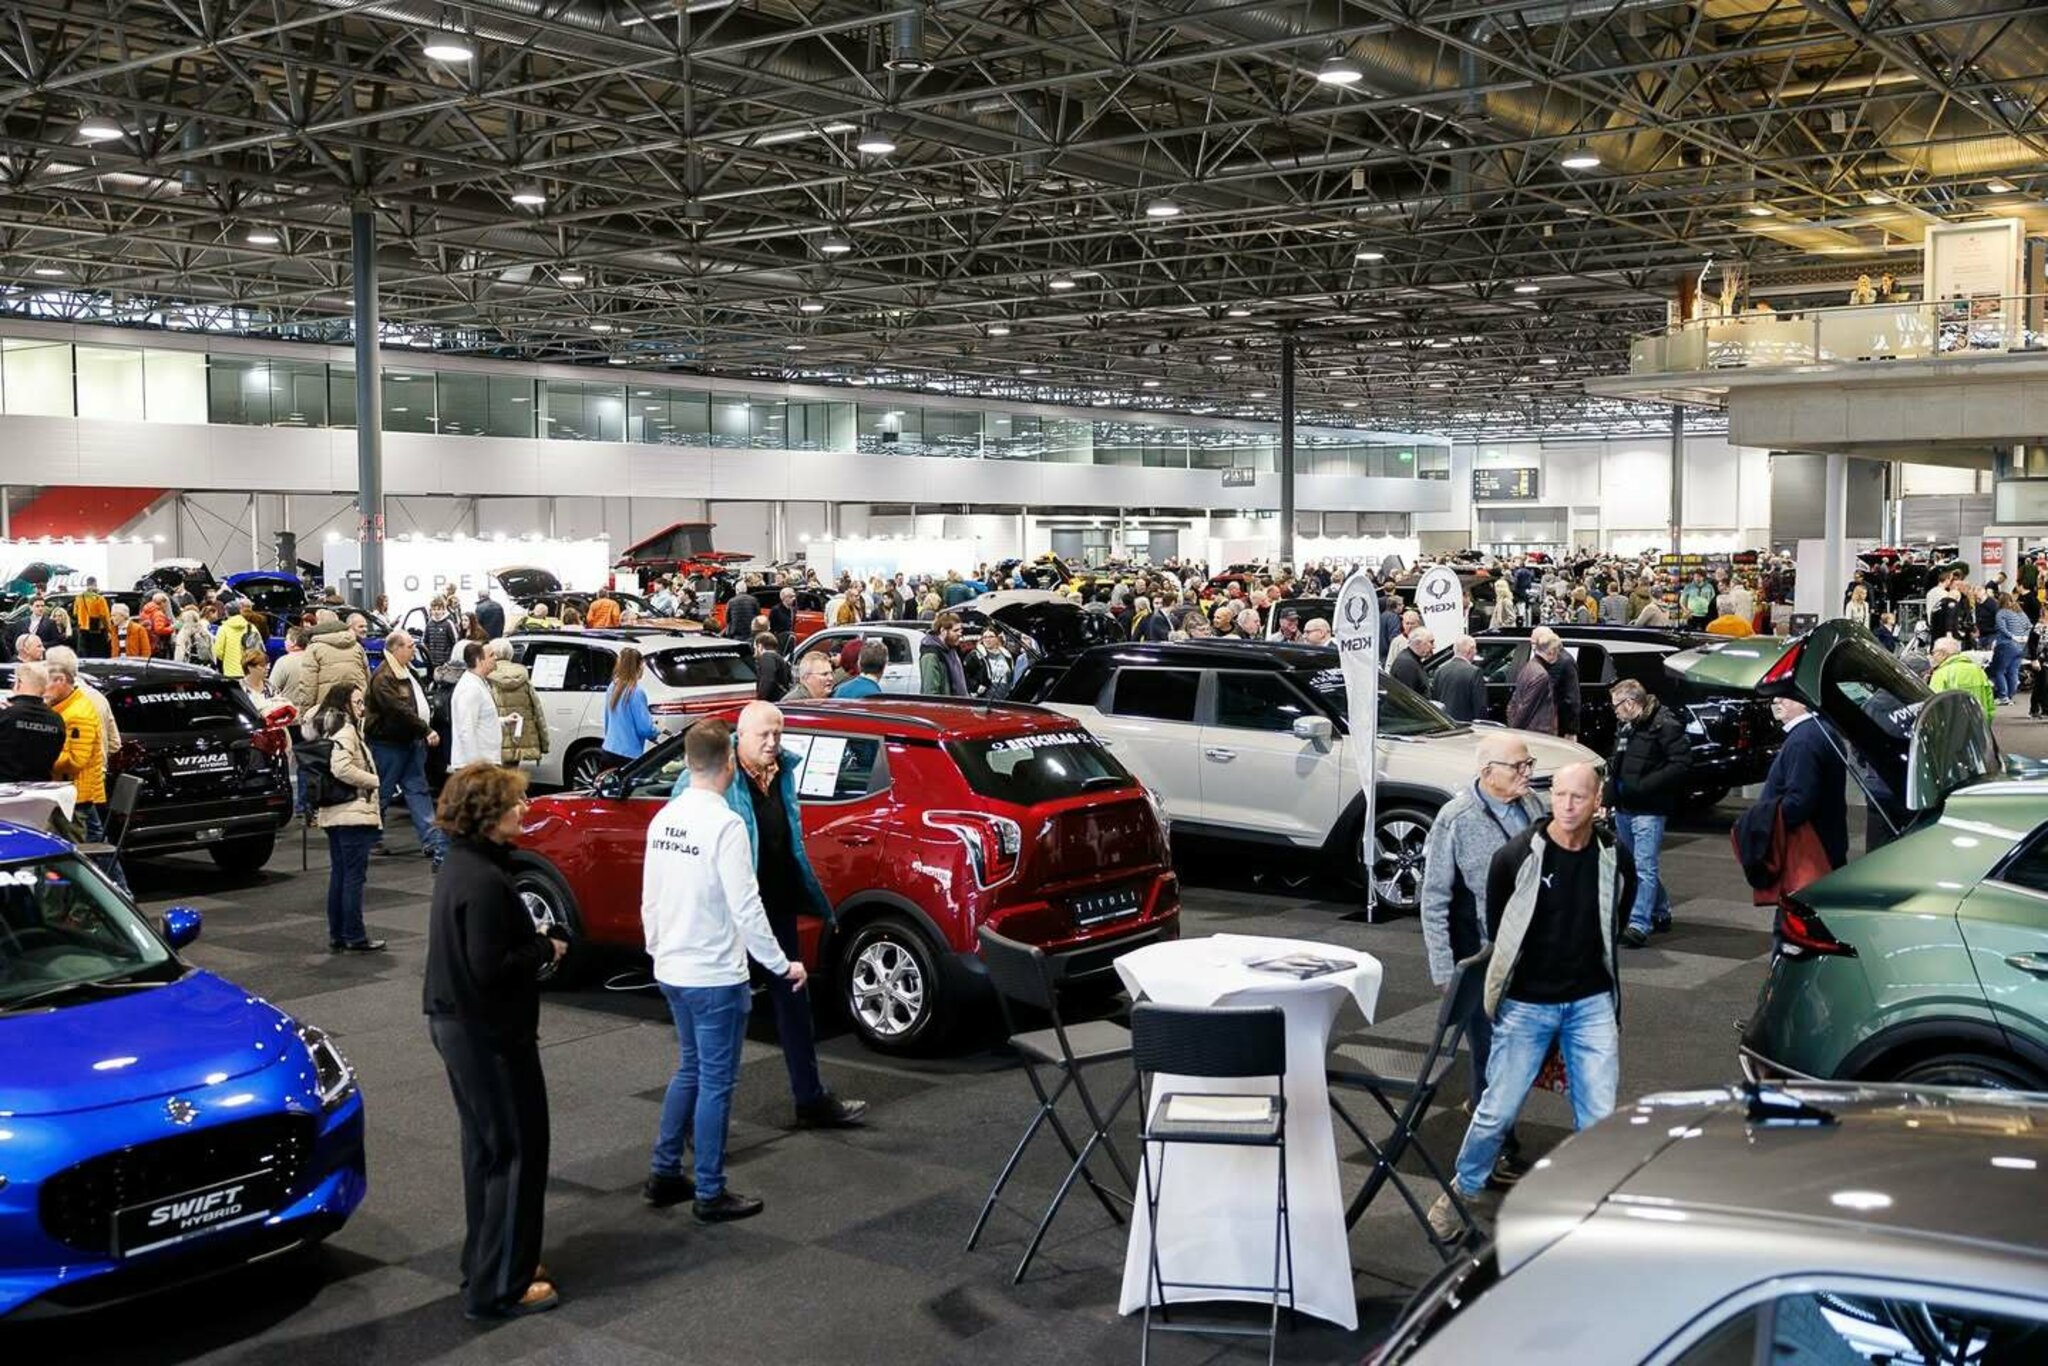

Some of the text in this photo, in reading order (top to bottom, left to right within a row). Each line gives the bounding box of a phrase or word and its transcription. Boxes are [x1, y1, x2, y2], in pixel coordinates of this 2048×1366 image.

[1322, 556, 1384, 567] DENZEL
[404, 574, 500, 592] OPEL
[136, 690, 213, 704] BEYSCHLAG
[15, 720, 58, 733] SUZUKI
[1005, 733, 1079, 750] BEYSCHLAG
[174, 753, 228, 766] VITARA
[200, 761, 228, 769] HYBRID
[665, 827, 687, 838] TEAM
[1075, 891, 1136, 913] TIVOLI
[147, 1185, 245, 1226] SWIFT
[180, 1203, 243, 1228] HYBRID
